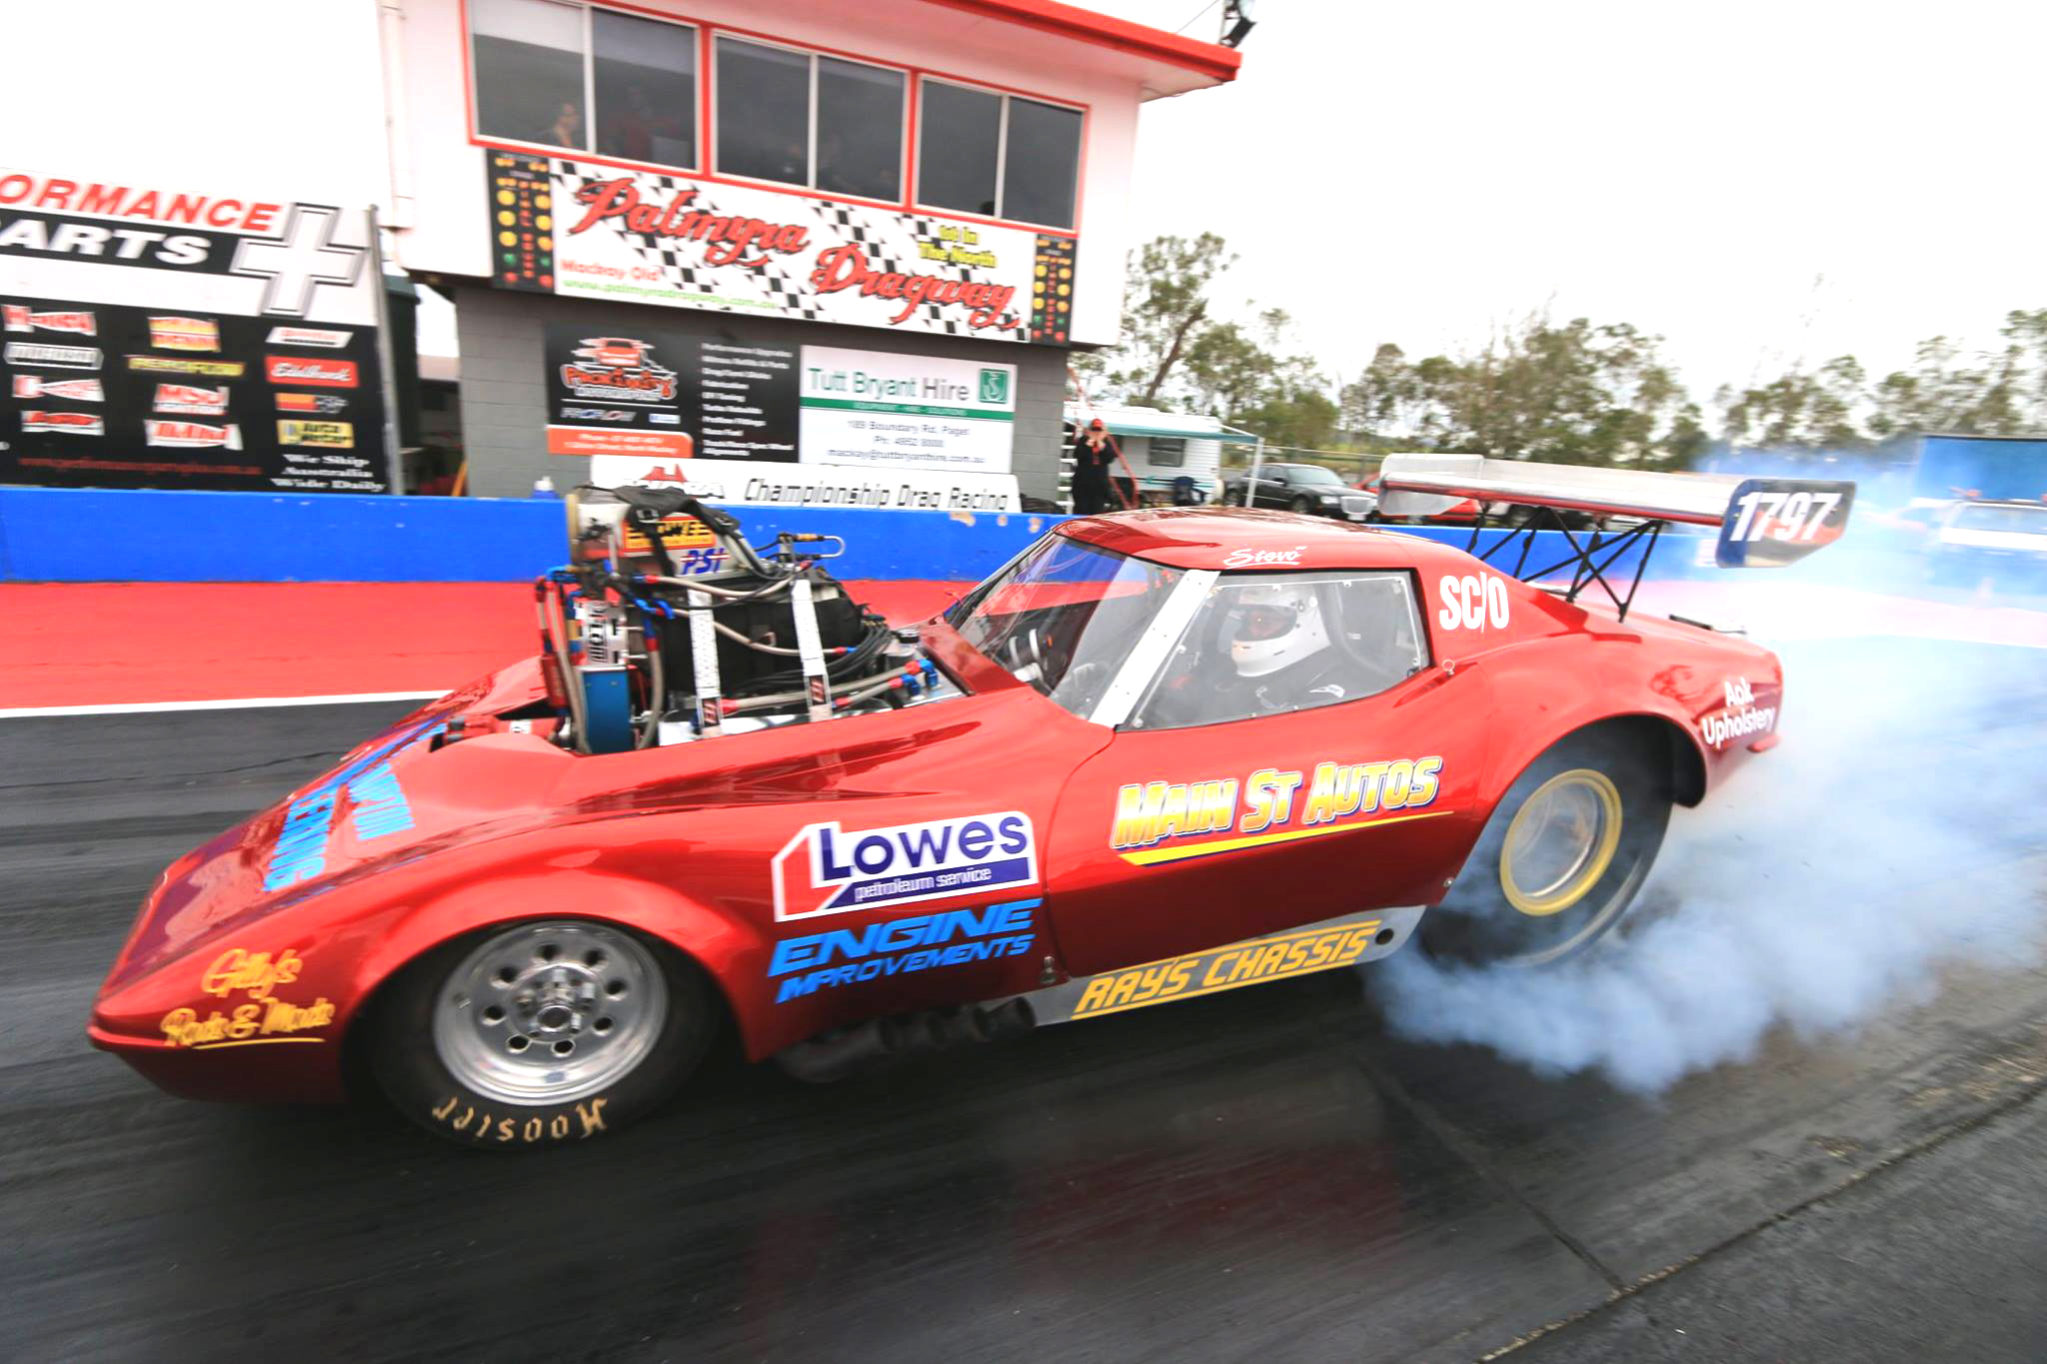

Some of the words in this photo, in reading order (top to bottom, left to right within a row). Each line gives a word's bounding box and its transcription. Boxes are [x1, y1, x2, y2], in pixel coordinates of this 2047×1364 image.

[567, 177, 811, 267] Palmyra
[810, 241, 1020, 328] Dragway
[808, 367, 848, 392] Tutt
[853, 371, 917, 399] Bryant
[921, 377, 970, 401] Hire
[270, 478, 328, 488] Wide
[283, 453, 320, 464] We
[322, 455, 370, 468] Ship
[745, 477, 890, 510] Championship
[897, 485, 941, 508] Drag
[949, 486, 1008, 511] Racing
[1729, 492, 1843, 542] 1797
[1702, 707, 1776, 749] Upholstery
[1110, 778, 1239, 849] MAIN
[1239, 768, 1303, 833] ST
[1302, 756, 1443, 825] AUTOS
[820, 816, 1028, 881] Lowes
[854, 875, 935, 902] petroleum
[936, 867, 992, 888] service
[767, 898, 1043, 977] ENGINE
[1202, 927, 1378, 988] CHASSIS
[776, 934, 1036, 1004] IMPROVEMENTS
